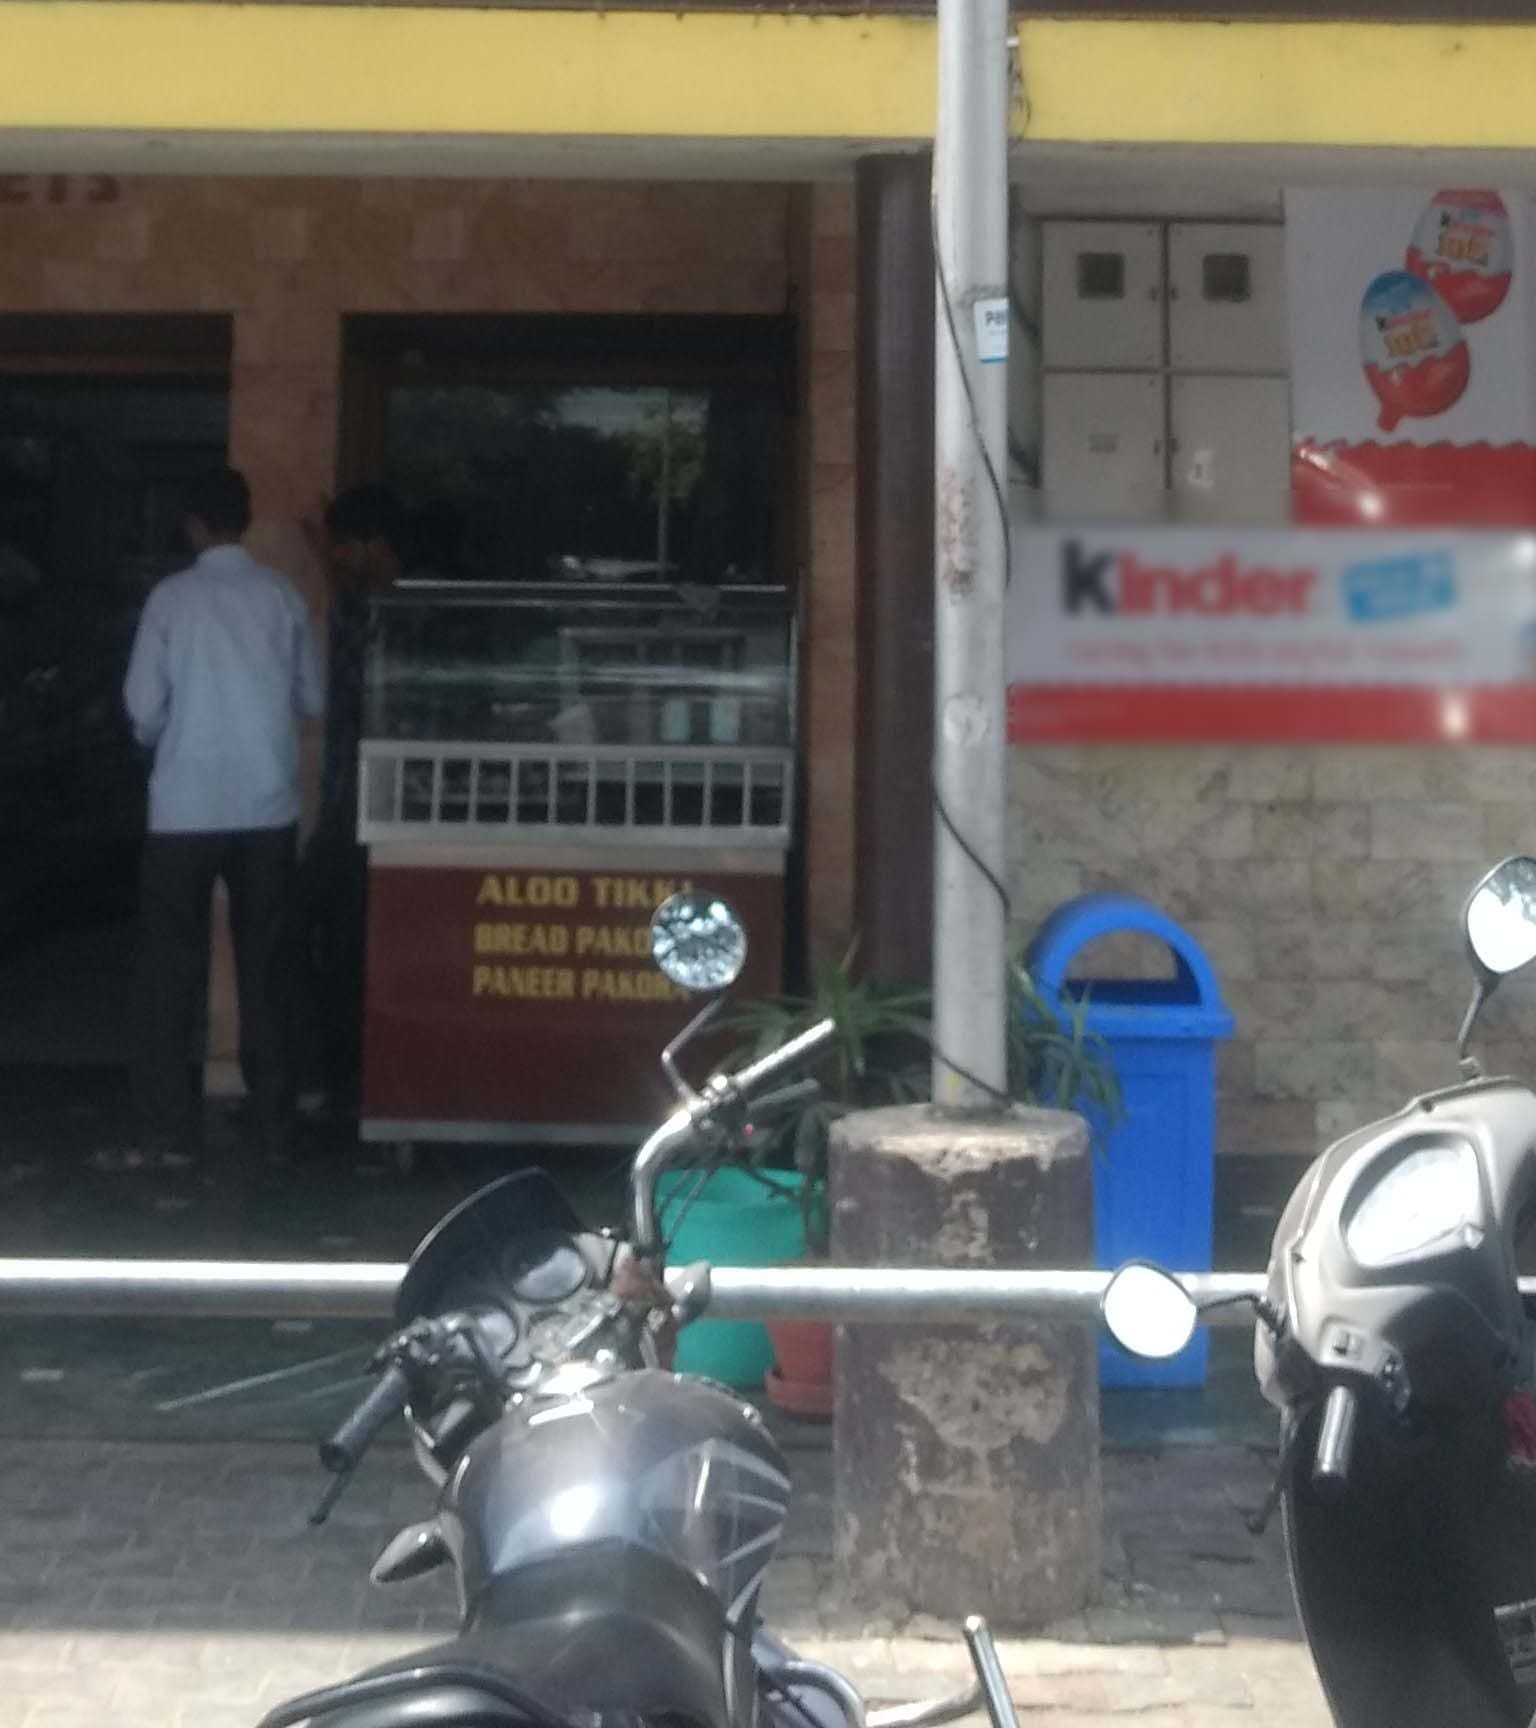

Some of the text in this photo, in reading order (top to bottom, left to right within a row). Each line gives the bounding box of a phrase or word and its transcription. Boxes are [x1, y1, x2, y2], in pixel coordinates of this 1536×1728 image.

[476, 875, 580, 908] ALOO
[474, 923, 656, 957] BREAD PAKO
[472, 965, 576, 996] PANEER
